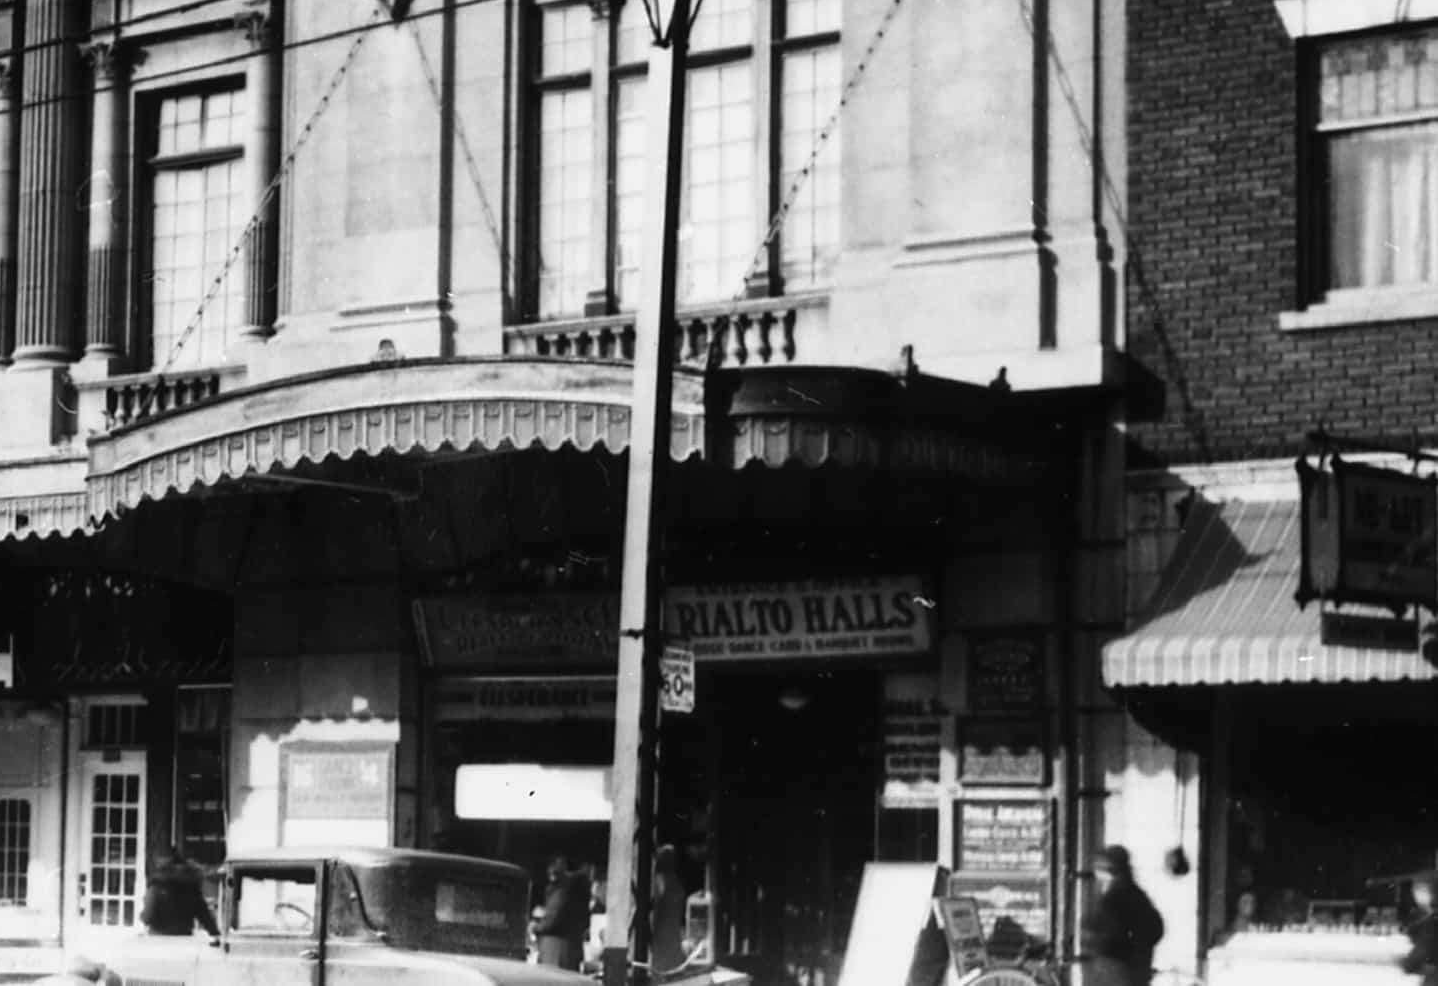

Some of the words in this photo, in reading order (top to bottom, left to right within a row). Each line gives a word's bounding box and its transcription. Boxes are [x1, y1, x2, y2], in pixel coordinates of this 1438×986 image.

[674, 598, 793, 638] RIALTO
[801, 590, 915, 634] HALLS
[662, 674, 683, 697] 60
